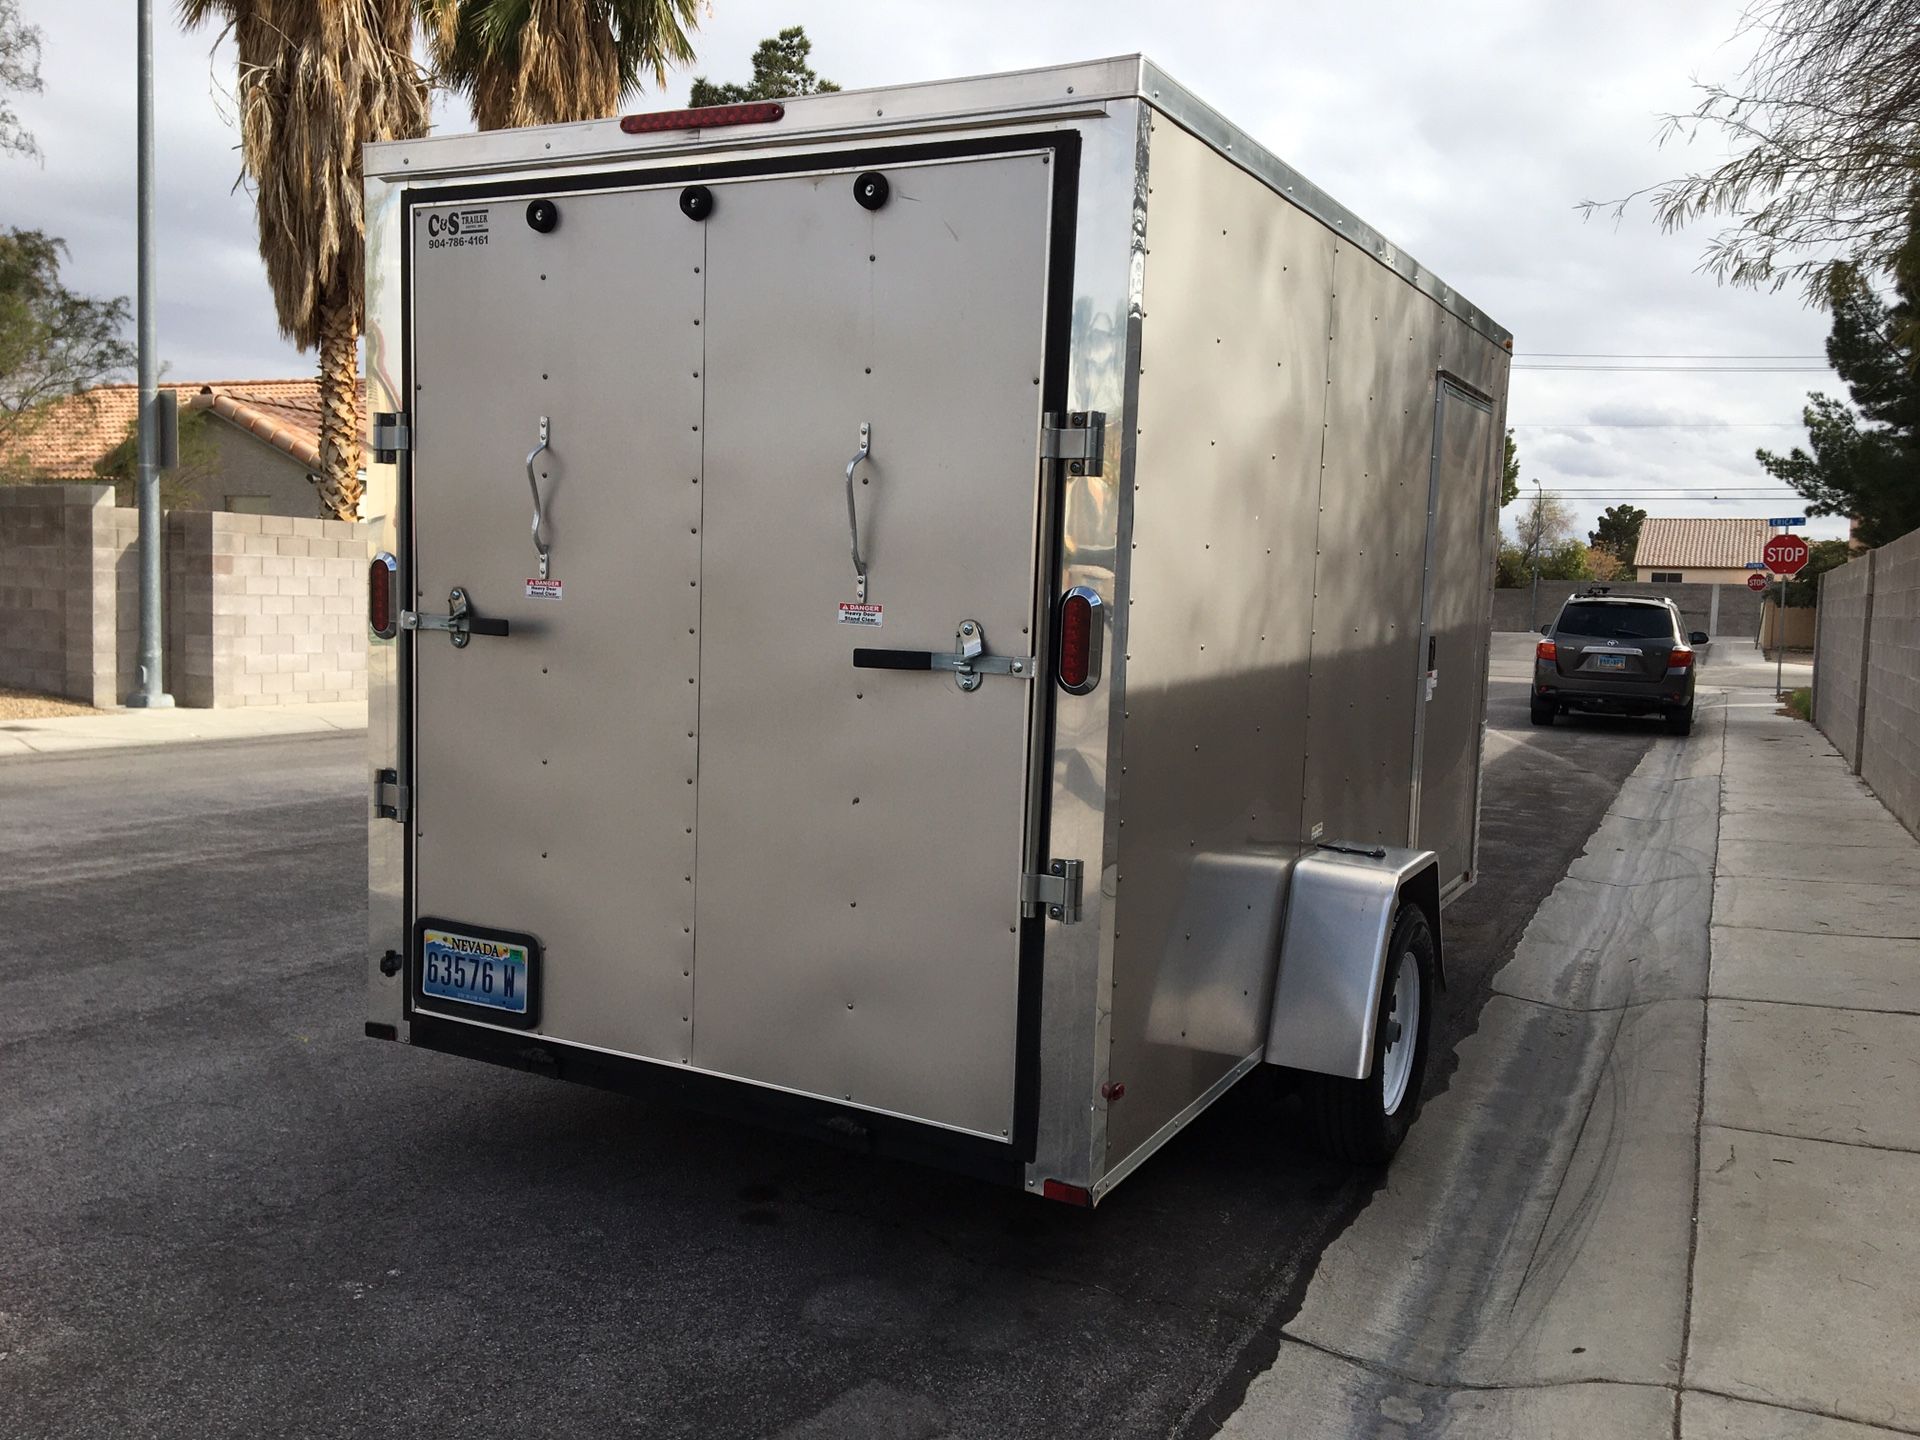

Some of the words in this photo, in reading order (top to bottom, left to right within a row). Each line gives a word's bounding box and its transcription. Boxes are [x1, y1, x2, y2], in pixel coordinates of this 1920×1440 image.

[428, 212, 460, 237] C&S
[461, 214, 488, 225] TRAILER
[428, 235, 488, 249] 904-786-4161
[1767, 547, 1805, 562] STOP
[1749, 578, 1765, 587] STOP
[450, 937, 500, 957] NEVADA
[427, 952, 494, 994] 63576
[503, 964, 516, 999] W
